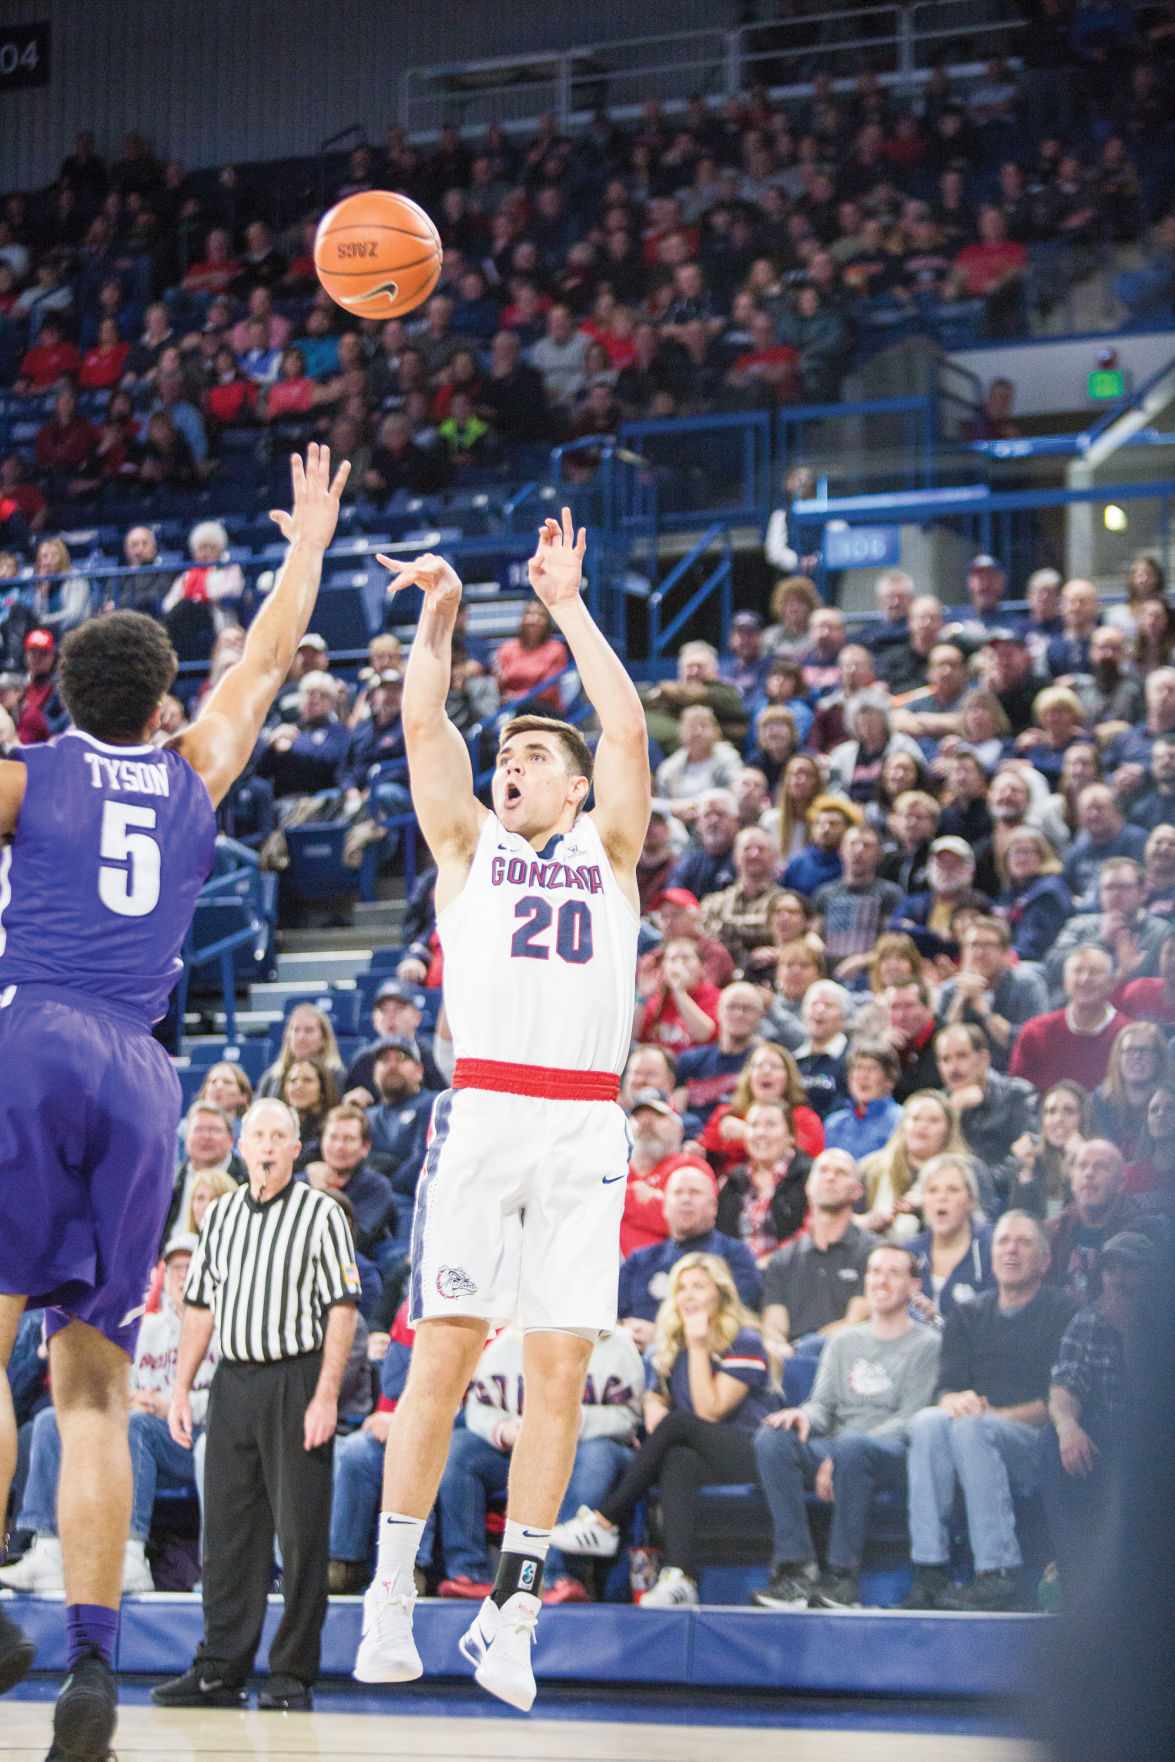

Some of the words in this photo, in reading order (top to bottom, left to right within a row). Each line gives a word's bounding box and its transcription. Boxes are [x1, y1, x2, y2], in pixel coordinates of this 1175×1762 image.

[337, 241, 378, 259] ZAGS
[84, 752, 170, 797] TYSON
[98, 800, 161, 917] 5
[511, 895, 594, 964] 20
